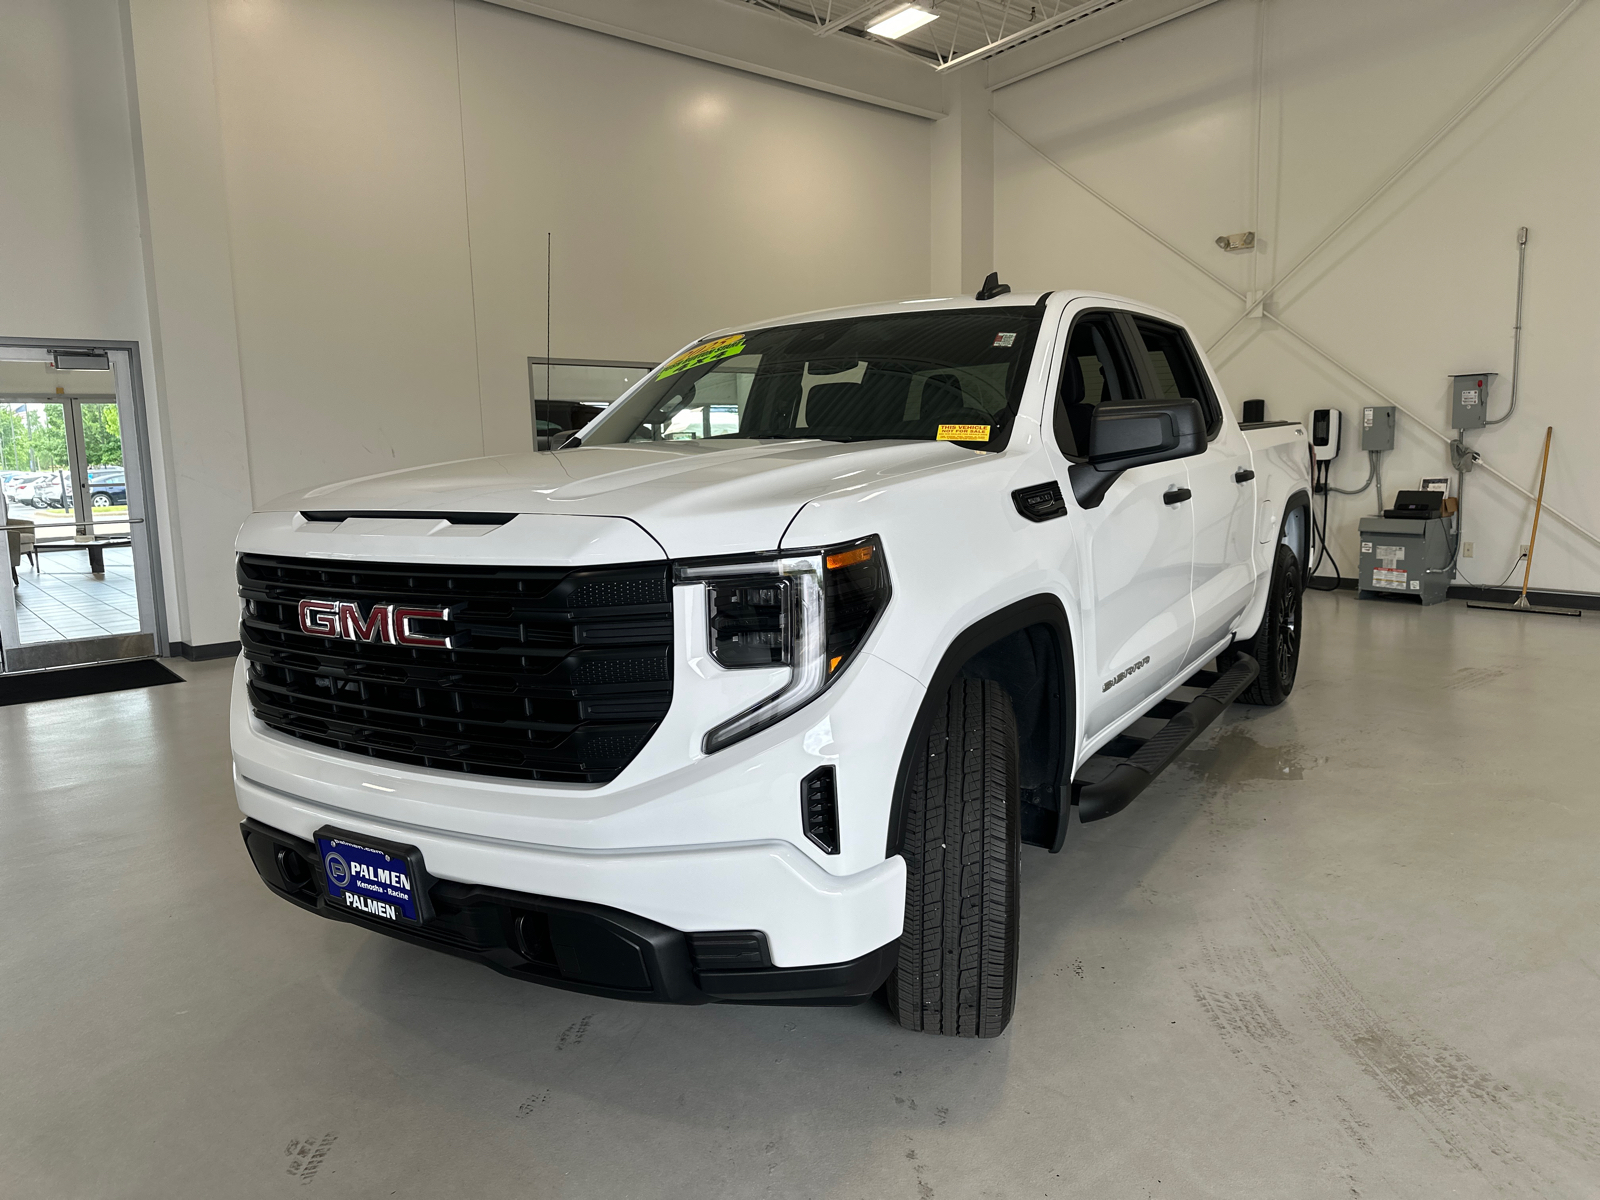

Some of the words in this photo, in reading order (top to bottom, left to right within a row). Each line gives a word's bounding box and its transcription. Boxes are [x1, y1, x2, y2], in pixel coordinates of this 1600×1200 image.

[299, 599, 453, 649] GMC
[350, 861, 411, 891] PALMEN
[356, 880, 383, 893] Kenosha
[387, 888, 409, 901] Racine
[345, 892, 397, 921] PALMEN
